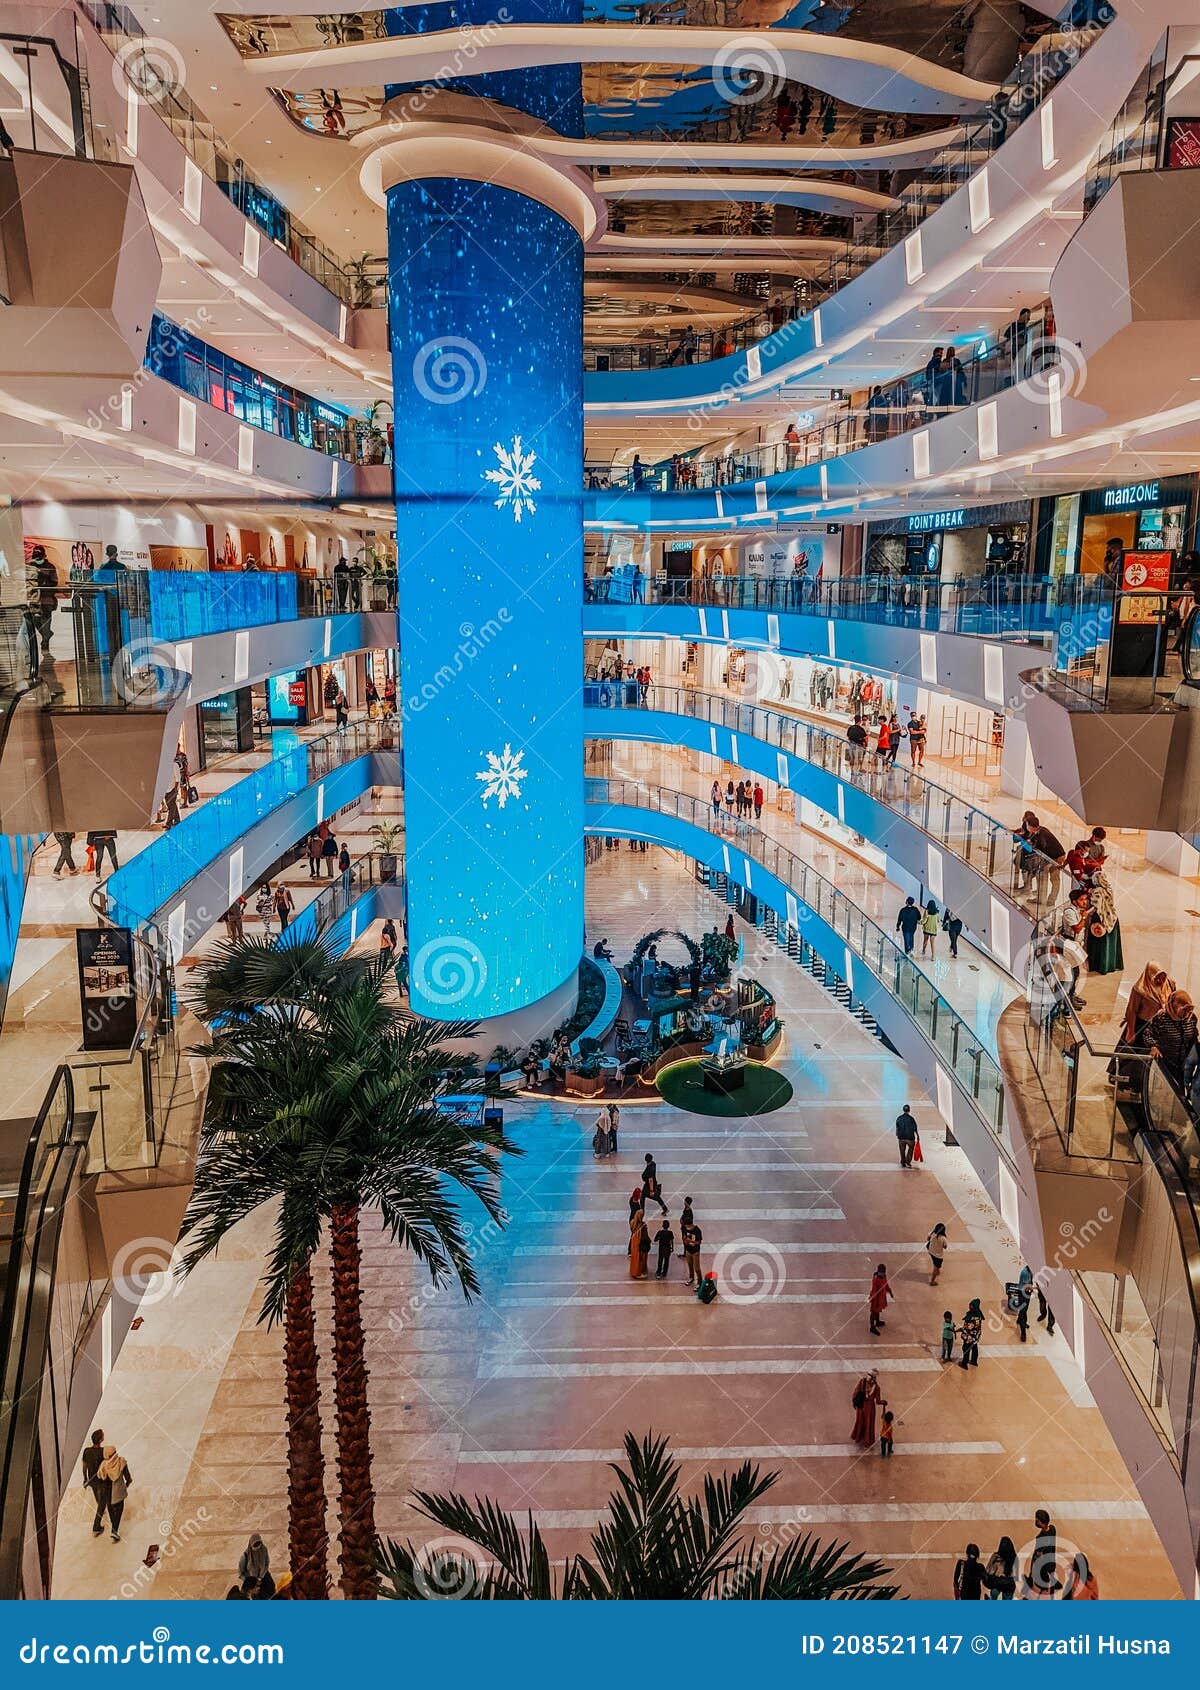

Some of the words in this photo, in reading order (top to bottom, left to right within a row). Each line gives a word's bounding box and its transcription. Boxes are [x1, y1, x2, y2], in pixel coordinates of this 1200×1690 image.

[1183, 139, 1200, 165] SA
[1105, 483, 1158, 505] manZONE
[909, 514, 933, 530] POINT
[935, 511, 964, 527] BREAK
